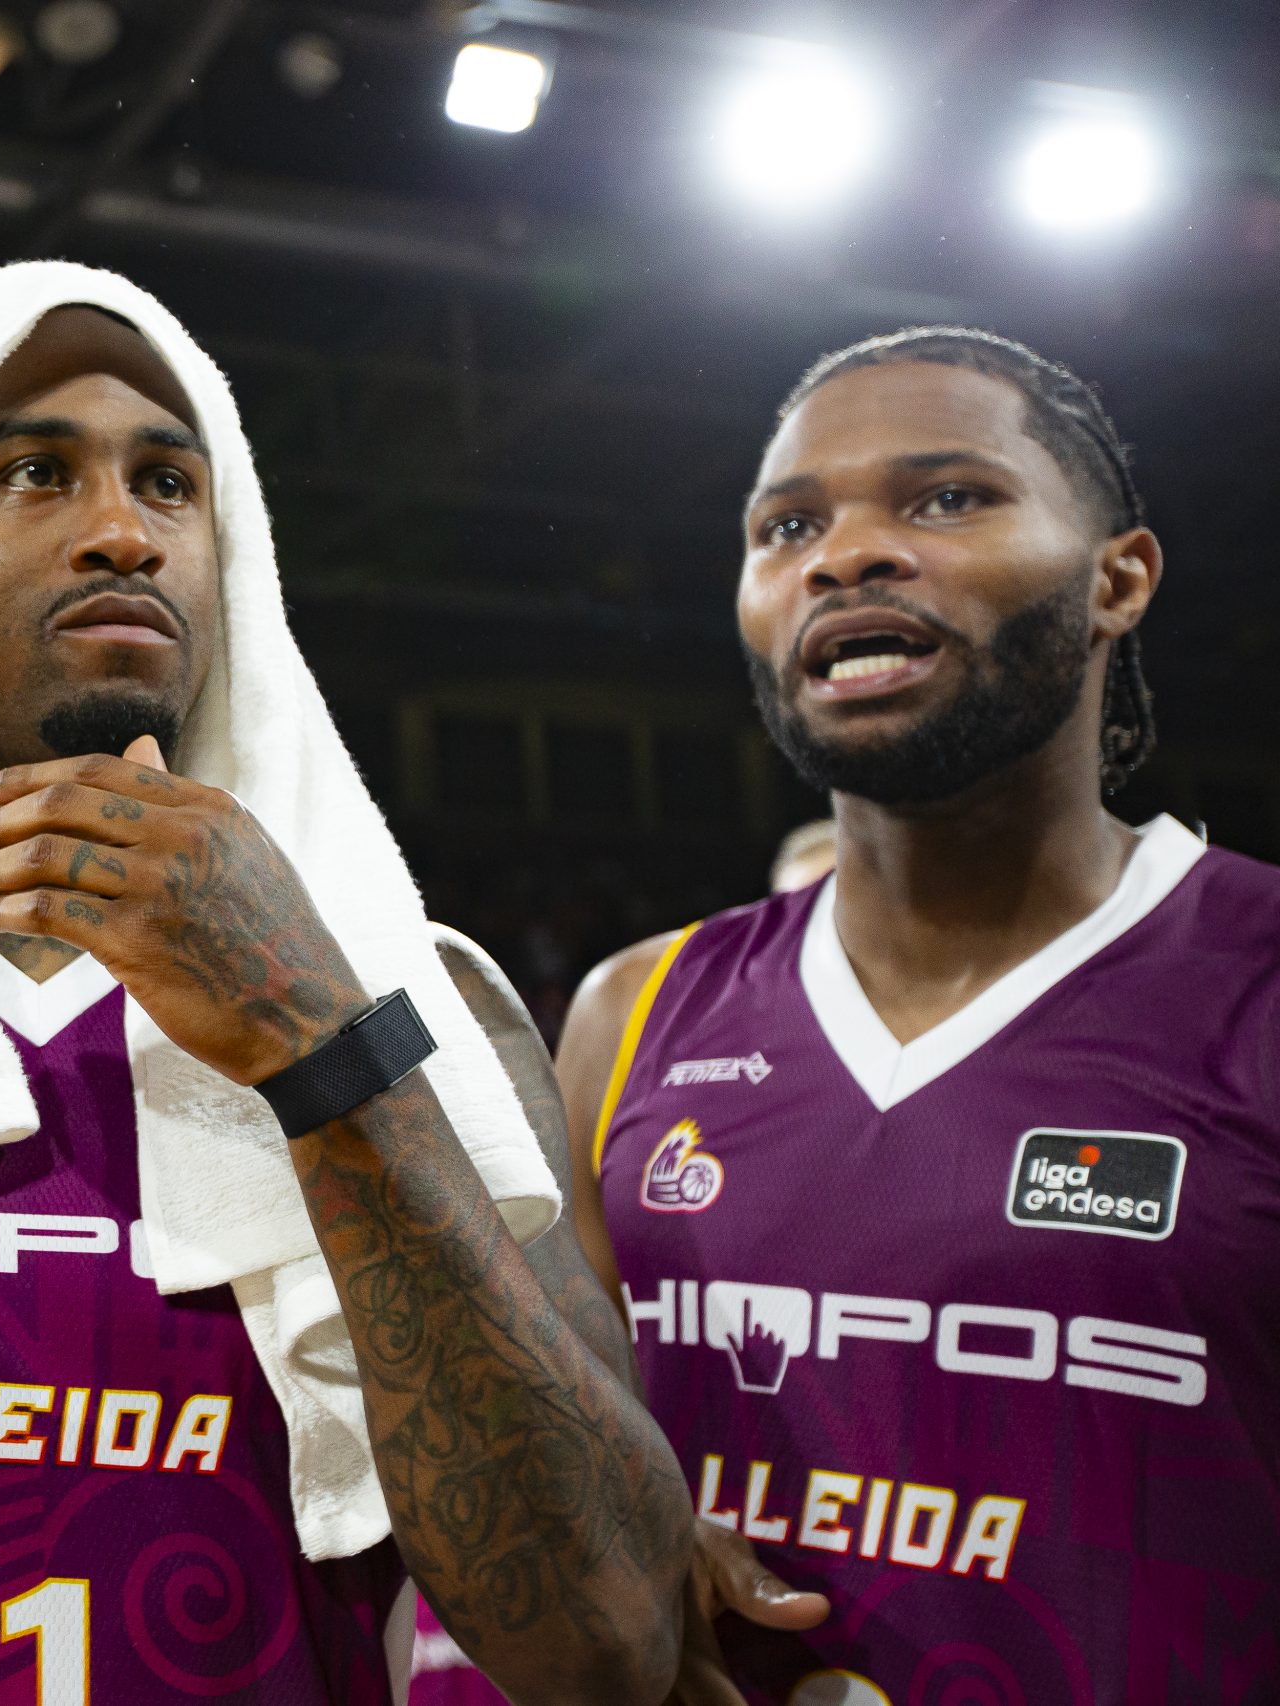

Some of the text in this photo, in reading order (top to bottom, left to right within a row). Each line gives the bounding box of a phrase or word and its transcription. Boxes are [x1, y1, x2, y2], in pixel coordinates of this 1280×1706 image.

[1023, 1187, 1161, 1224] endesa
[1028, 1156, 1091, 1190] liga
[621, 1278, 1208, 1407] HIOPOS
[697, 1452, 1028, 1583] LLEIDA
[0, 1576, 91, 1706] 1
